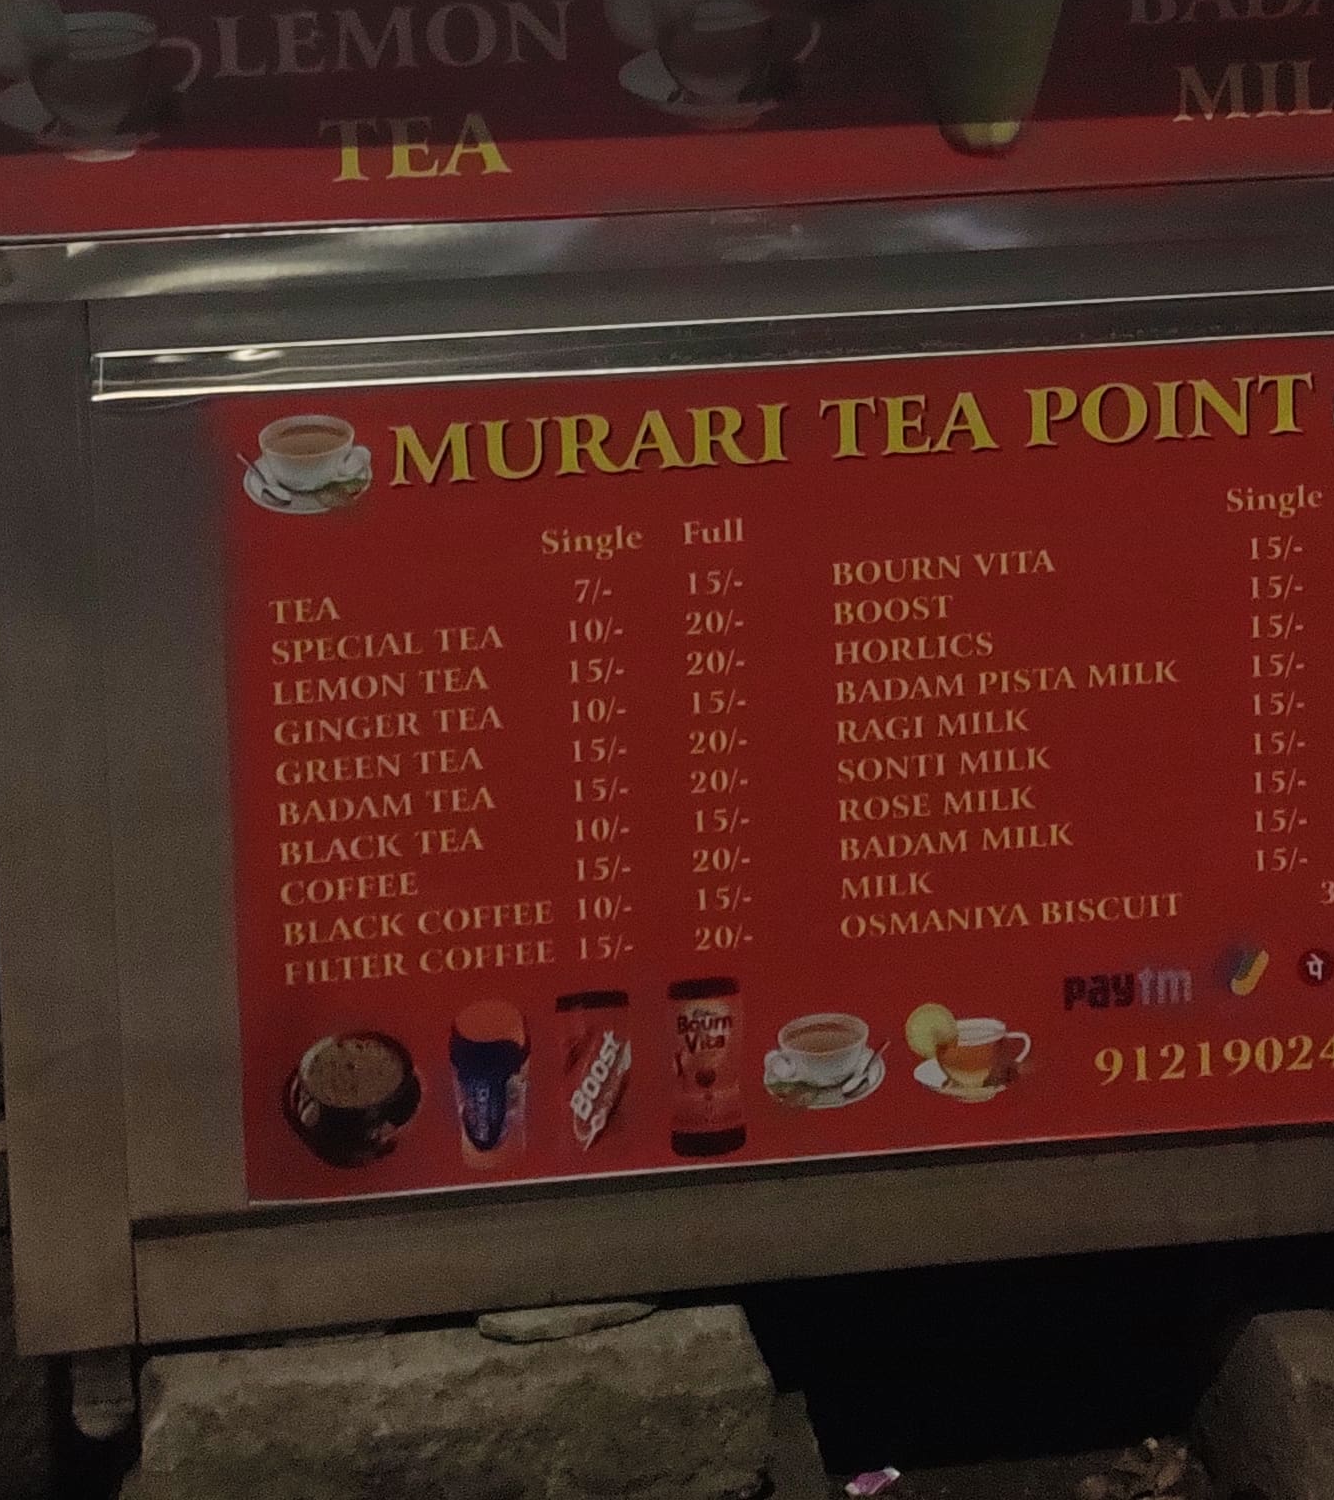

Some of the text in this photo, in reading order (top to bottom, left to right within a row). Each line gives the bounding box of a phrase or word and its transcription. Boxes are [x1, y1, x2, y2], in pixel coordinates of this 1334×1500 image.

[213, 0, 571, 80] LEMON
[319, 111, 513, 183] TEA
[387, 372, 1316, 488] MURARI TEA POINT
[1226, 485, 1322, 518] Single
[542, 518, 744, 560] Single Full
[832, 555, 962, 587] BOURN
[974, 549, 1055, 580] VITA
[1250, 536, 1303, 561] 15/-
[270, 570, 743, 624] TEA 7/- 15/-
[833, 595, 953, 626] BOOST
[1250, 575, 1303, 600] 15/-
[271, 611, 743, 664] SPECIAL TEA 10/- 20/-
[834, 632, 994, 665] HORLICS
[1250, 614, 1304, 640] 15/-
[273, 650, 745, 705] LEMON TEA 15/- 20/-
[835, 674, 965, 705] BADAM
[979, 667, 1076, 696] PISTA
[1088, 659, 1178, 690] MILK
[1251, 653, 1305, 679] 15/-
[274, 689, 746, 746] GINGER TEA 10/- 15/-
[836, 716, 924, 744] RAGI
[938, 708, 1029, 738] MILK
[1251, 692, 1305, 718] 15/-
[276, 729, 747, 786] GREEN TEA 15/- 20/-
[837, 753, 945, 784] SONTI
[959, 747, 1051, 777] MILK
[1252, 732, 1305, 757] 15/-
[277, 768, 748, 827] BADAM TEA 15/- 20/-
[838, 794, 931, 823] ROSE
[944, 787, 1035, 816] MILK
[1253, 770, 1306, 795] 15/-
[279, 808, 750, 867] BLACK TEA 10/- 15/-
[839, 830, 967, 863] BADAM
[982, 823, 1073, 853] MILK
[1254, 809, 1308, 835] 15/-
[280, 847, 751, 907] COFFEE 15/- 20/-
[840, 871, 932, 901] MILK
[1255, 848, 1308, 874] 15/-
[284, 886, 752, 947] BLACK COFFEE 10/- 15/-
[840, 903, 1029, 940] OSMANIYA
[1042, 892, 1182, 925] BISCUIT
[285, 925, 753, 986] FILTER COFFEE 15/- 20/-
[677, 1014, 732, 1036] Bourn
[684, 1033, 725, 1054] Vita
[570, 1030, 620, 1122] BOOST
